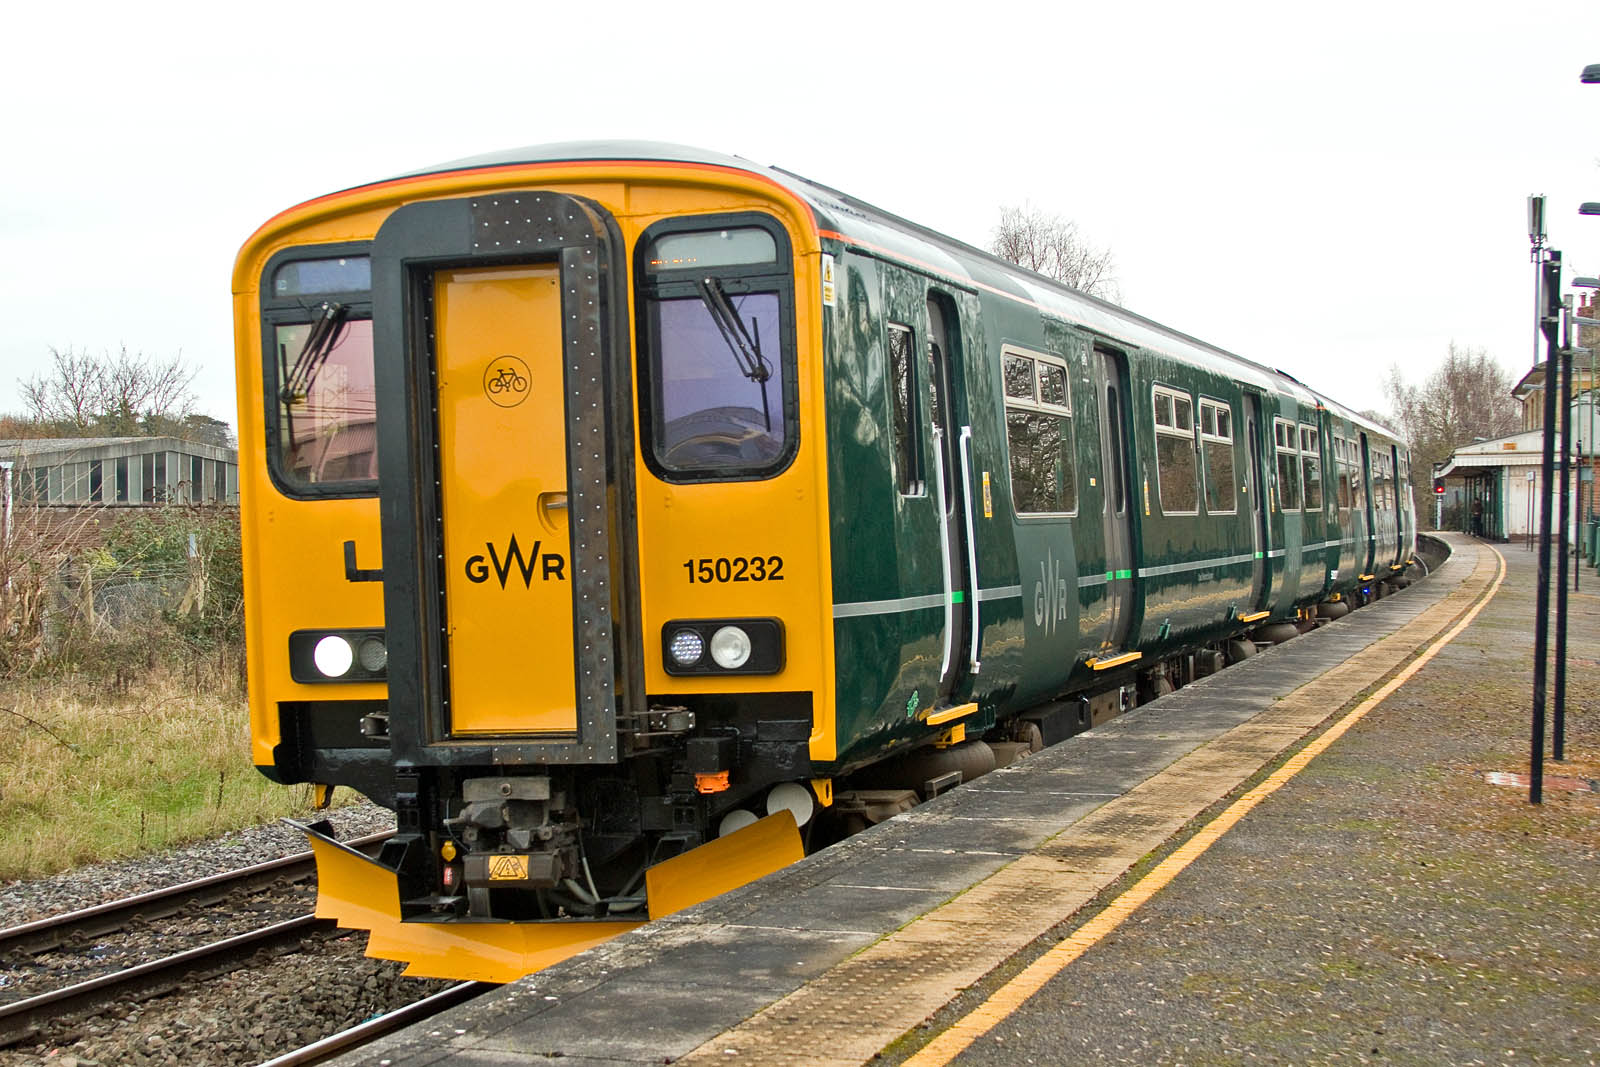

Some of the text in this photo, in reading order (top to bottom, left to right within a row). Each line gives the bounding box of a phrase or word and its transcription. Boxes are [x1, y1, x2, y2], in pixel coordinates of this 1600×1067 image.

[465, 532, 565, 590] GWR
[683, 556, 784, 583] 150232
[1035, 546, 1067, 637] GWR
